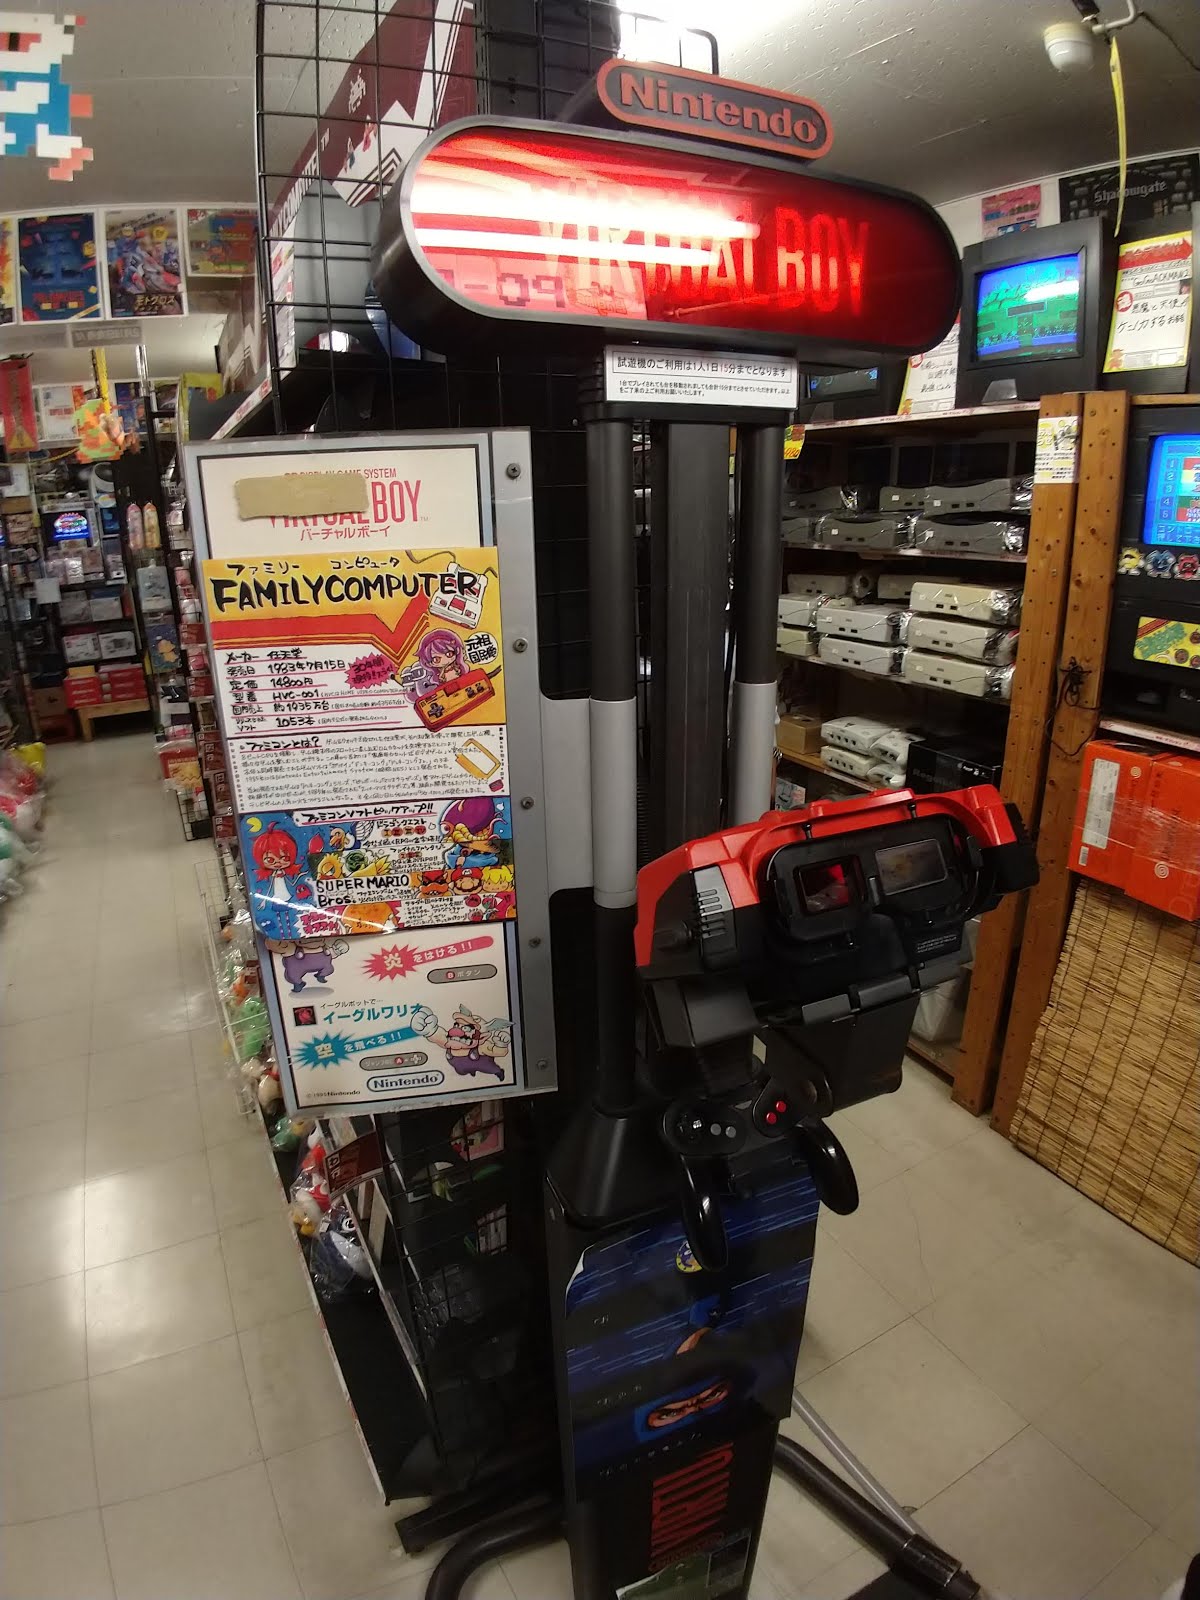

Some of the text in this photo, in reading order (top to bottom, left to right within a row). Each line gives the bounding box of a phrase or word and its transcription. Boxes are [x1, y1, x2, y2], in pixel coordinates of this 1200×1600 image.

[619, 72, 817, 144] Nintendo
[775, 206, 870, 316] BOY
[617, 356, 788, 378] 試遊機のご利用は1人1日15分までとなります
[363, 468, 397, 479] SYSTEM
[371, 480, 421, 523] BOY
[301, 525, 391, 541] バーチャルボーイ
[227, 556, 400, 576] ファミリー コンピュータ
[210, 571, 478, 613] FAMILYCOMPUTER
[226, 647, 302, 664] メーカー 任天堂
[268, 659, 346, 674] 1983年7月15日
[270, 676, 314, 688] 14800円
[276, 716, 315, 728] 1053本
[246, 736, 320, 751] ファミコンとは?
[316, 874, 409, 894] SUPER MARIO
[318, 893, 357, 908] Bros.
[373, 1073, 440, 1089] Nintendo
